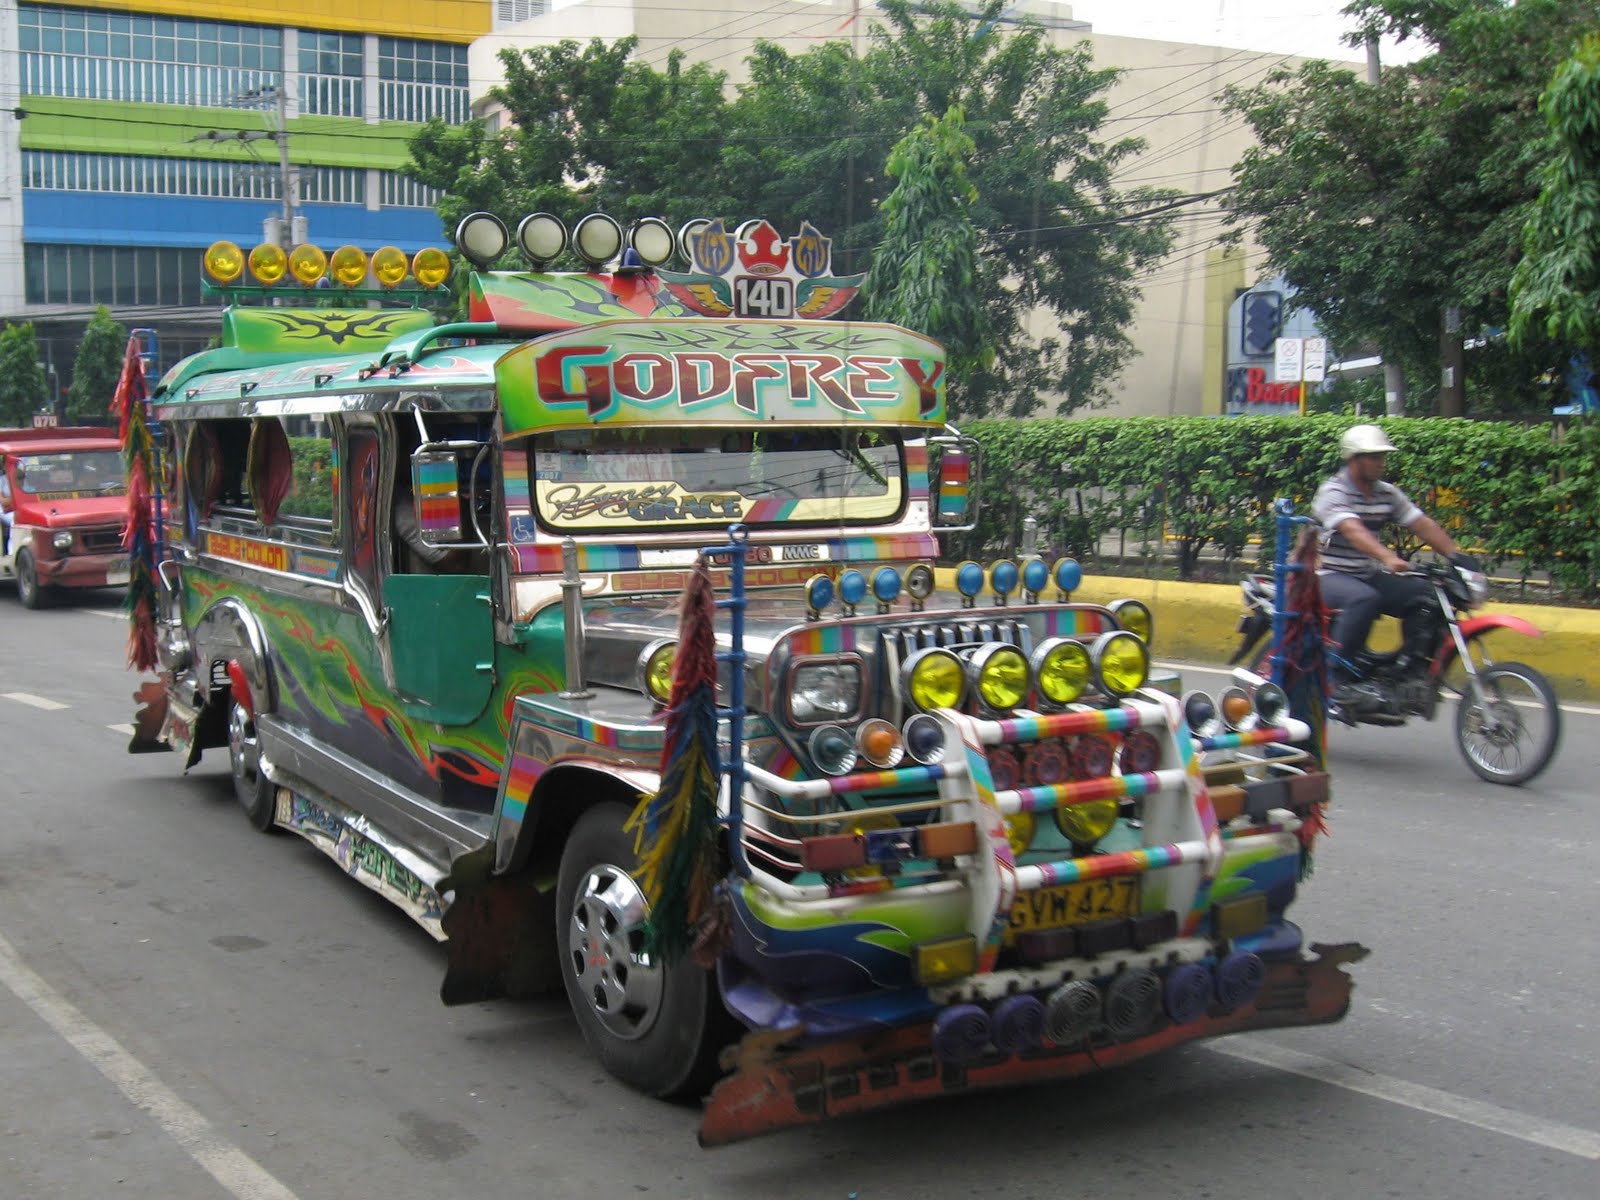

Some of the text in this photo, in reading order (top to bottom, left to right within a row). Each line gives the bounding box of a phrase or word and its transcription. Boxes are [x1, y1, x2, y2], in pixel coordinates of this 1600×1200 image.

[536, 345, 945, 416] GODFREY
[627, 494, 744, 522] GRACE
[782, 544, 820, 560] MMC
